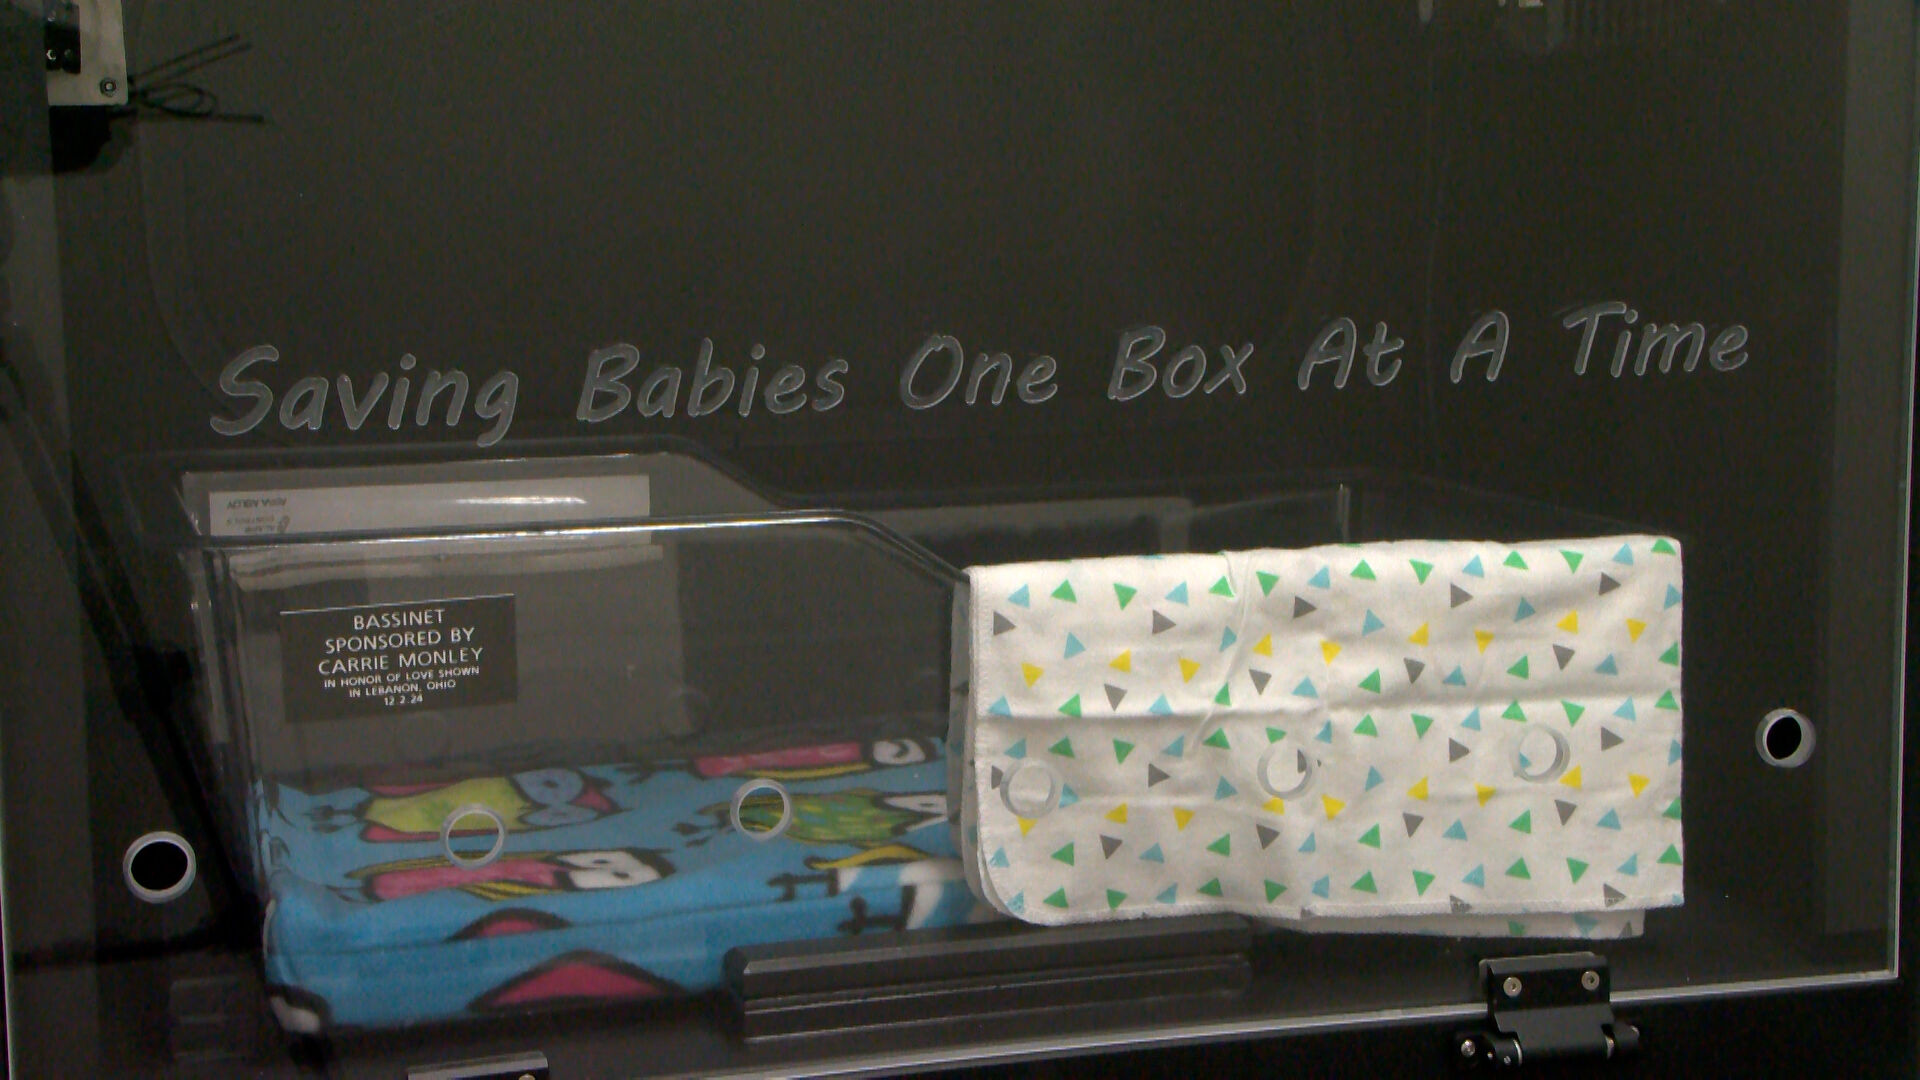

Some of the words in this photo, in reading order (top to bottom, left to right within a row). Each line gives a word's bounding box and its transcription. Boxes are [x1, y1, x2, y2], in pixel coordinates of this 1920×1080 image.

[210, 345, 519, 447] Saving
[576, 337, 849, 422] Babies
[901, 335, 1058, 409] One
[1108, 326, 1254, 401] Box
[1298, 317, 1404, 390] At
[1450, 310, 1509, 384] A
[1563, 301, 1748, 378] Time
[353, 609, 445, 630] BASSINET
[325, 630, 441, 654] SPONSORED
[451, 626, 474, 643] BY
[318, 656, 389, 675] CARRIE
[399, 647, 483, 668] MONLEY
[324, 679, 336, 689] IN
[340, 674, 382, 687] HONOR
[386, 672, 400, 683] OF
[405, 669, 433, 681] LOVE
[438, 665, 480, 678] SHOWN
[349, 688, 361, 698] IN
[426, 679, 456, 690] OHIO
